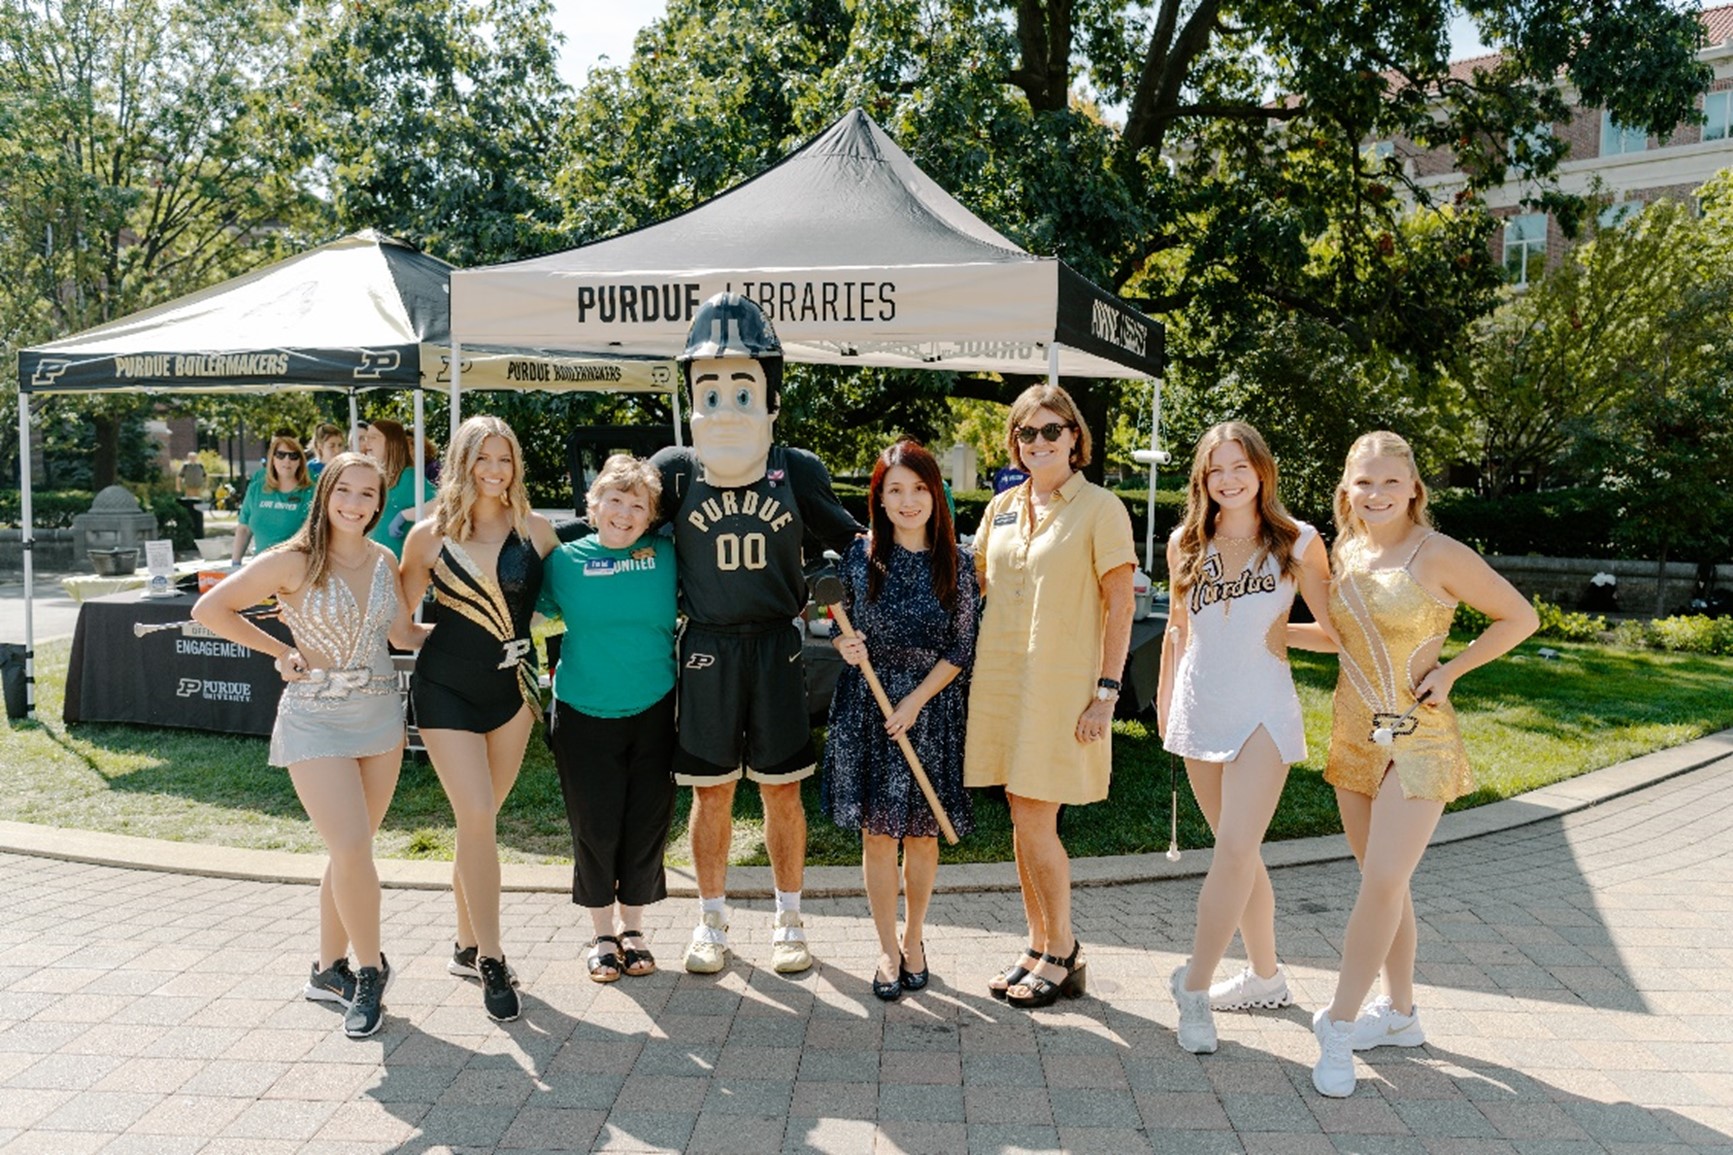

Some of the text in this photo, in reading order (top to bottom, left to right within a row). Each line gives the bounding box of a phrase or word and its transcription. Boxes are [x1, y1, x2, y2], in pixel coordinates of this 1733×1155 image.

[577, 282, 897, 323] PURDUE BRARIES
[114, 353, 289, 378] PURDUE BOILERMAKERS
[353, 349, 400, 379] P
[506, 360, 551, 382] PURDUE
[687, 489, 794, 533] PURDUE
[715, 532, 768, 571] 00
[175, 639, 252, 658] ENGAGEMENT
[685, 652, 716, 670] P
[176, 678, 252, 698] P PURDUE
